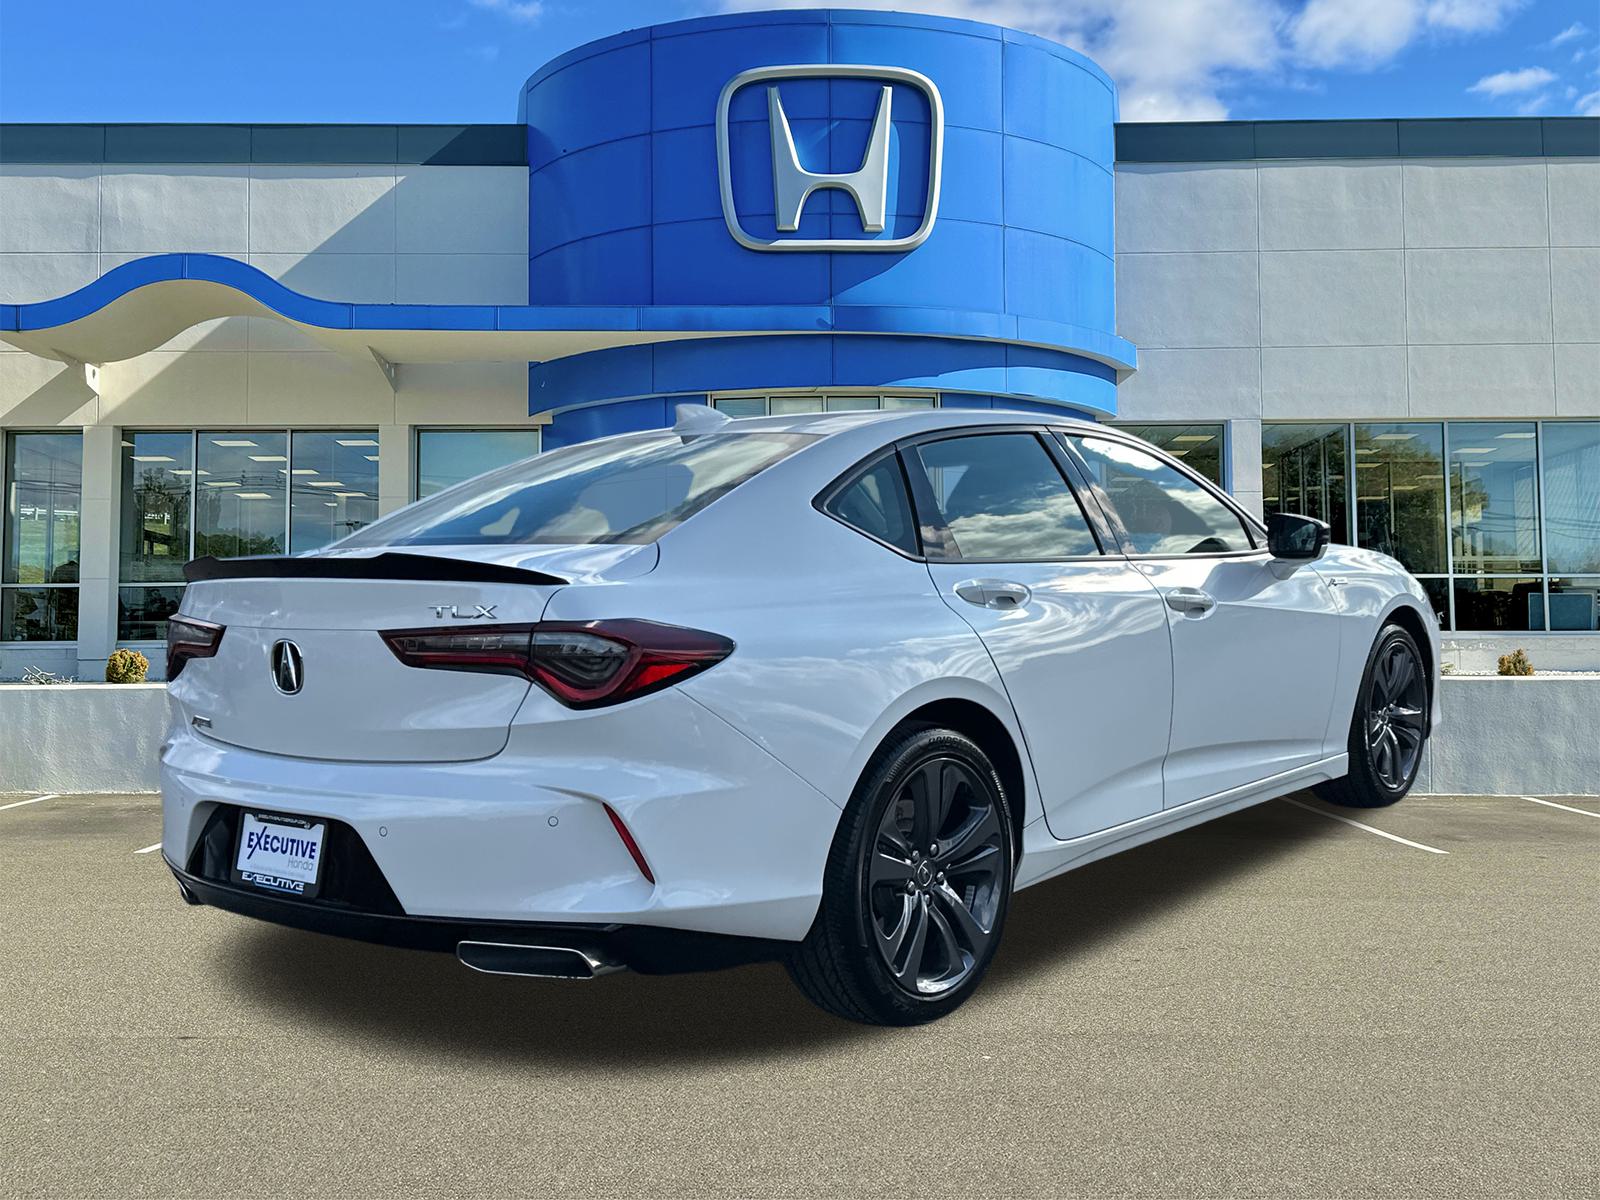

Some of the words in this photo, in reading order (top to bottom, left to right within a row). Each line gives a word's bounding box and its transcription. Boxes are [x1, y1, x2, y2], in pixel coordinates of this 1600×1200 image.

[428, 605, 497, 619] TLX
[246, 825, 317, 860] EXECUTIVE
[287, 857, 314, 871] Honda
[241, 871, 304, 891] EXECUTIVE
